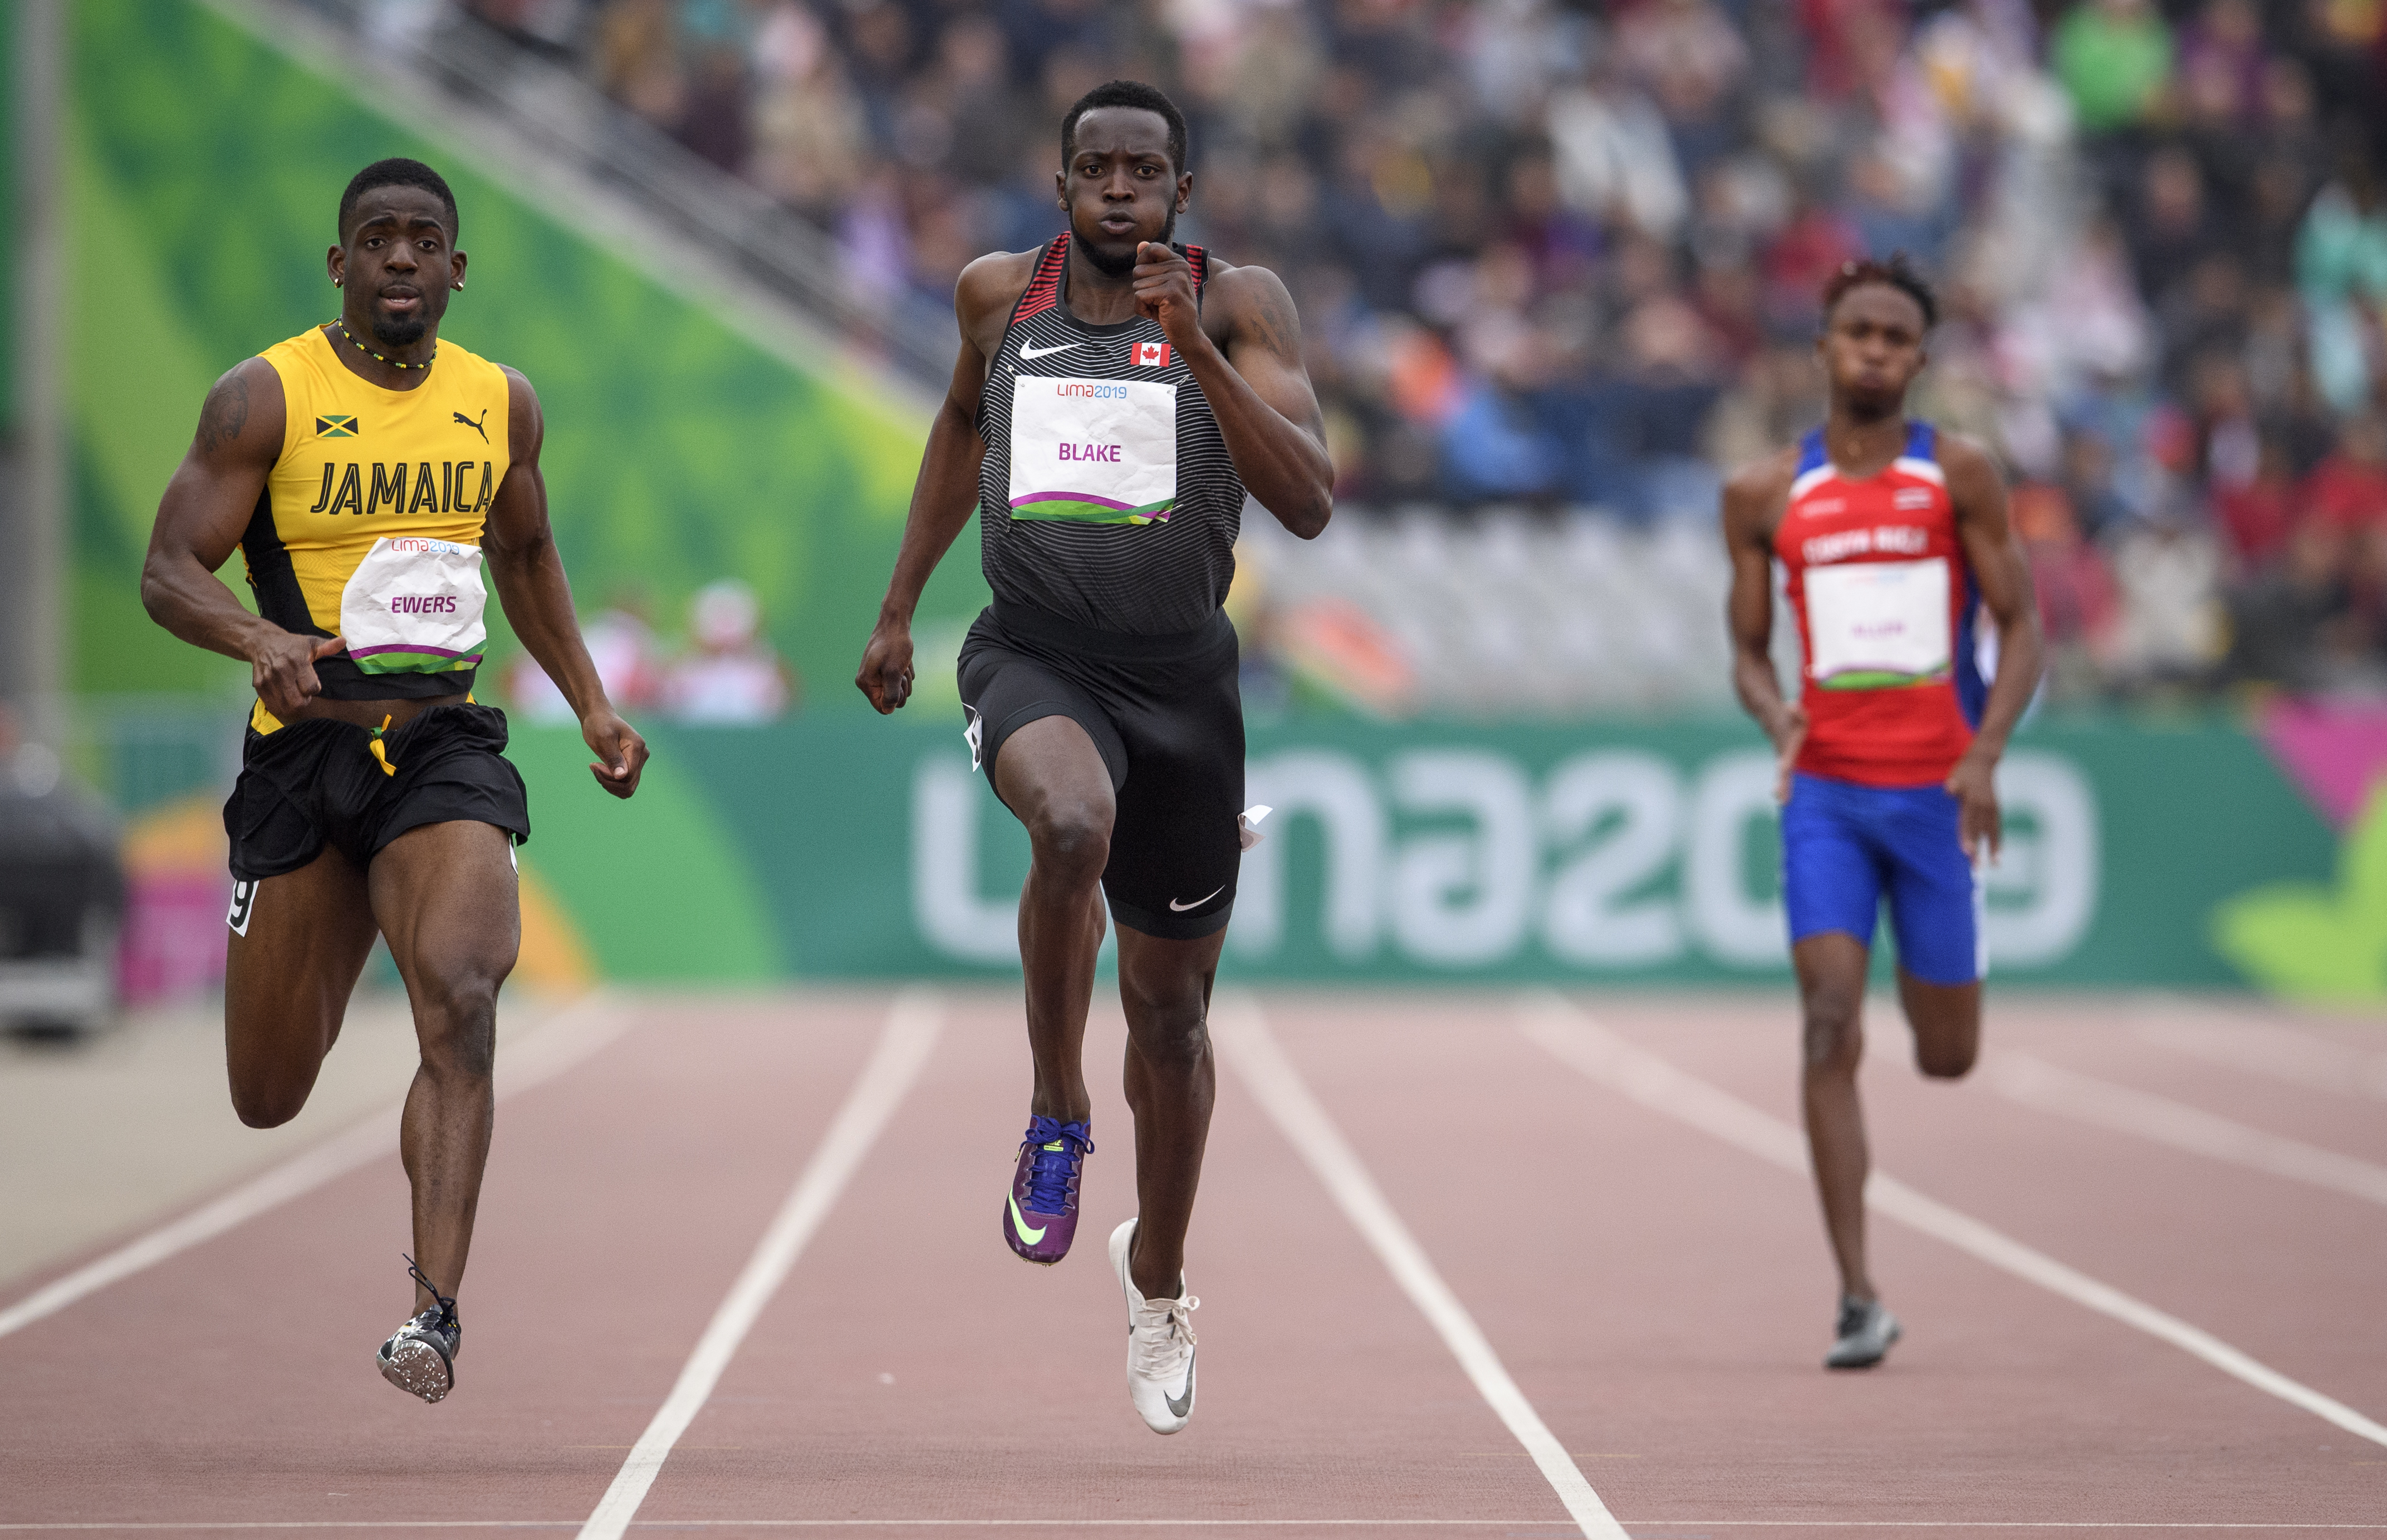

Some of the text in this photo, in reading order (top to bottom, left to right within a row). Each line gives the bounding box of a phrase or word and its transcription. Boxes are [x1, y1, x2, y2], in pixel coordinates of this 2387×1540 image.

[1059, 443, 1121, 462] BLAKE
[310, 461, 492, 515] JAMAICA
[391, 596, 457, 613] EWERS
[229, 880, 253, 928] 9
